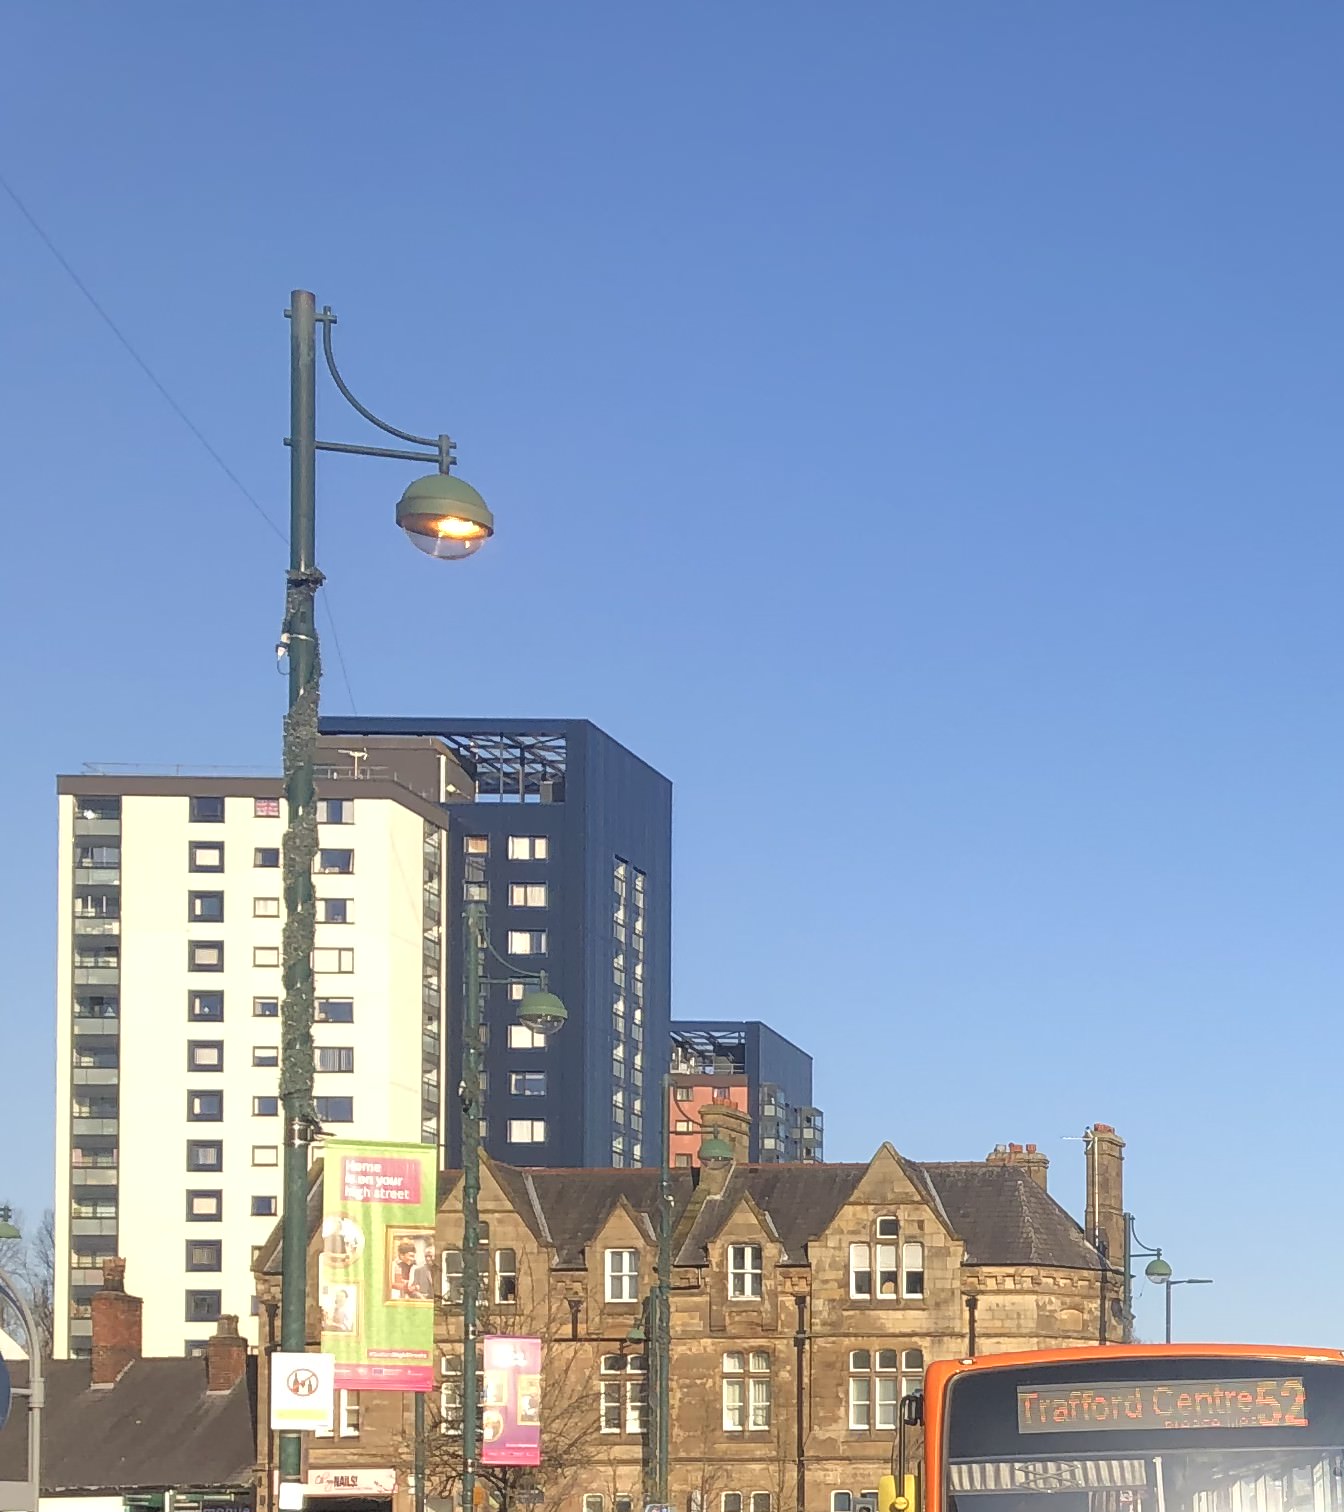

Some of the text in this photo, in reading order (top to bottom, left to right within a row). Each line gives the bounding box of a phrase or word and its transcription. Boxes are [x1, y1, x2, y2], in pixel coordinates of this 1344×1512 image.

[376, 1176, 404, 1187] your
[373, 1188, 410, 1200] street
[1018, 1379, 1309, 1427] Trafford Centre 52
